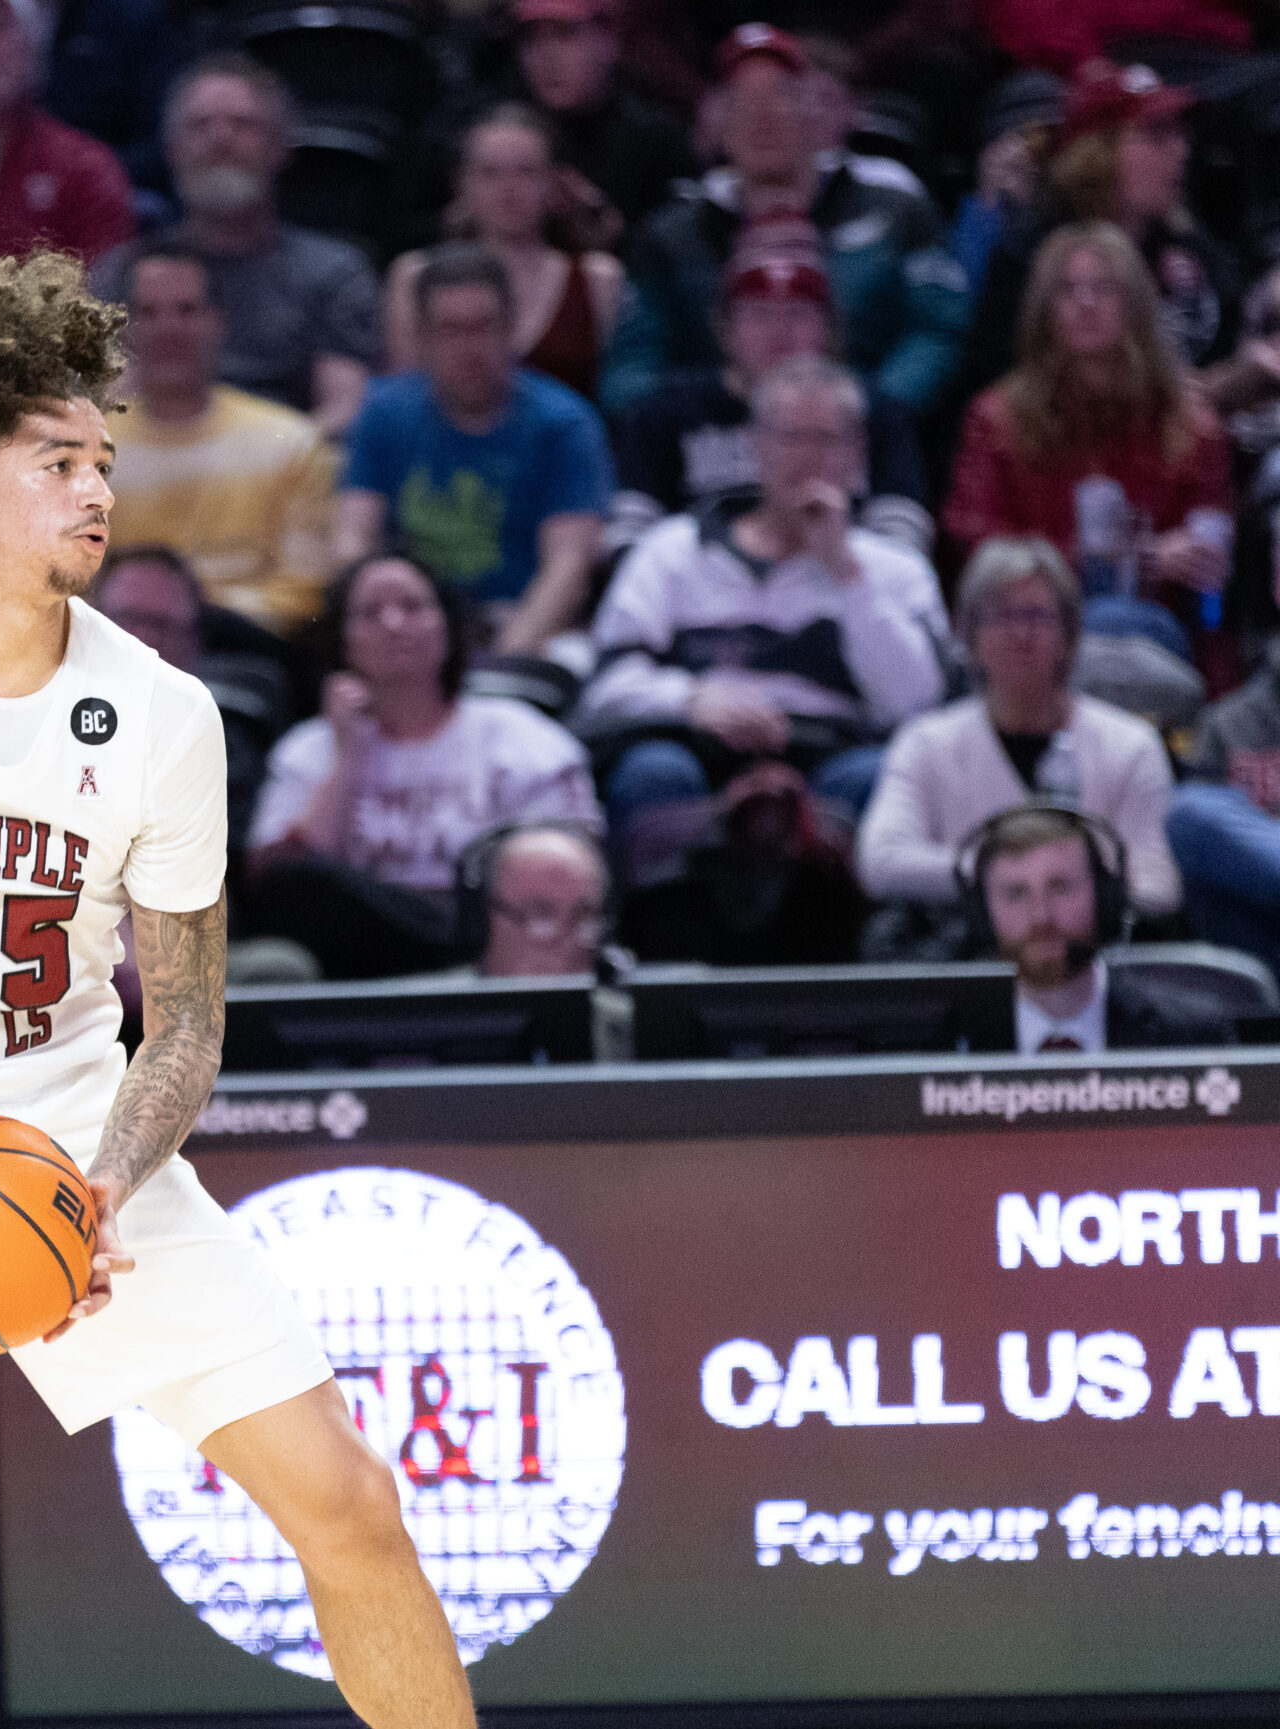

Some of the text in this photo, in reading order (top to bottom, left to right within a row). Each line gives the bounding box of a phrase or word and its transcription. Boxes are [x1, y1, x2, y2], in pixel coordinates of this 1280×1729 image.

[81, 710, 108, 734] BC
[922, 1071, 1190, 1122] Independence
[700, 1334, 984, 1428] CALL
[997, 1329, 1152, 1421] US
[755, 1500, 874, 1566] For
[884, 1506, 1048, 1576] your
